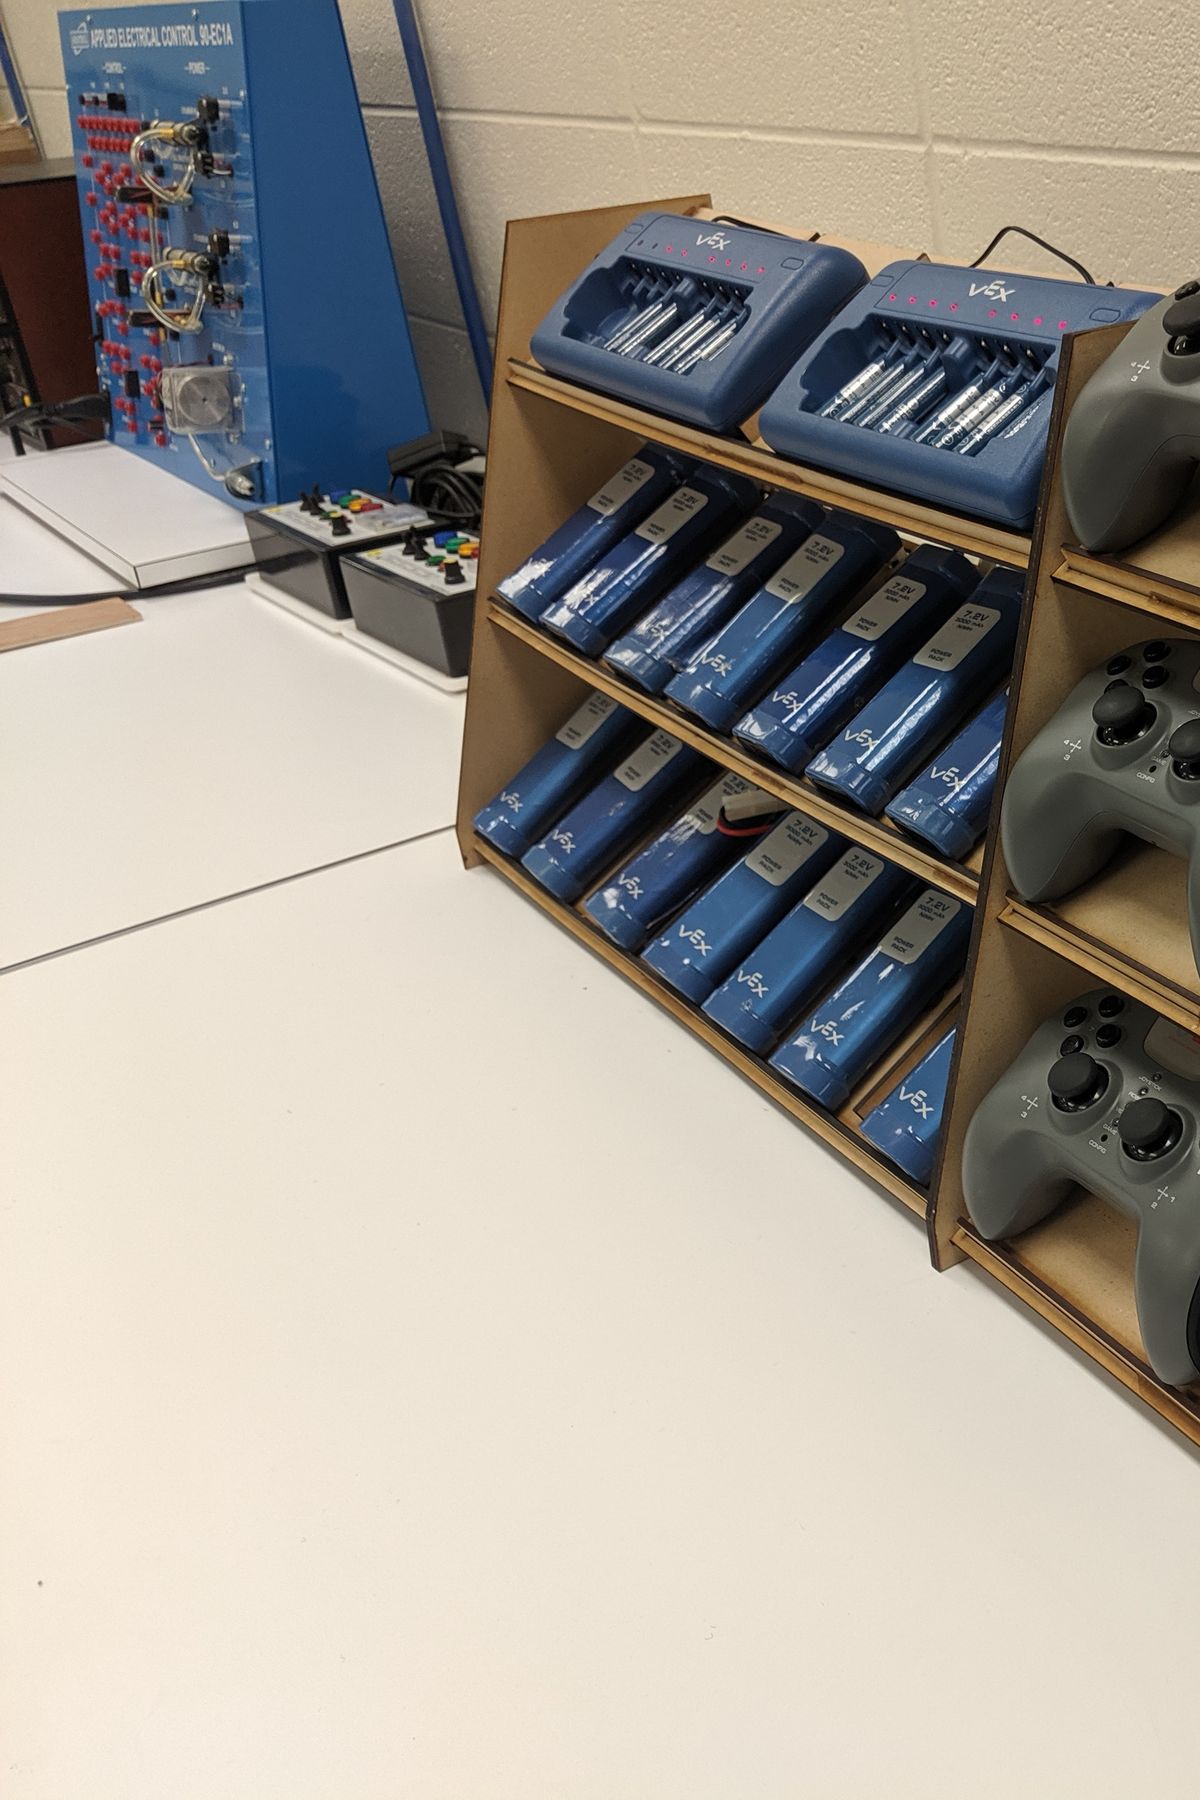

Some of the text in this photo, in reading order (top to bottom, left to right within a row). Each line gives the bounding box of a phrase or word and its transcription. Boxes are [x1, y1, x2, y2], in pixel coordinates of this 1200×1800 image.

[90, 26, 118, 48] APPLIED
[119, 25, 161, 48] ELECTRICAL
[161, 24, 199, 47] CONTROL
[850, 855, 875, 871] 7.2V
[926, 897, 950, 912] 7.2V
[678, 924, 713, 957] VEX
[736, 970, 769, 999] VEX
[810, 1019, 845, 1046] VEX
[899, 1086, 934, 1120] VEX
[1020, 1111, 1028, 1119] 3
